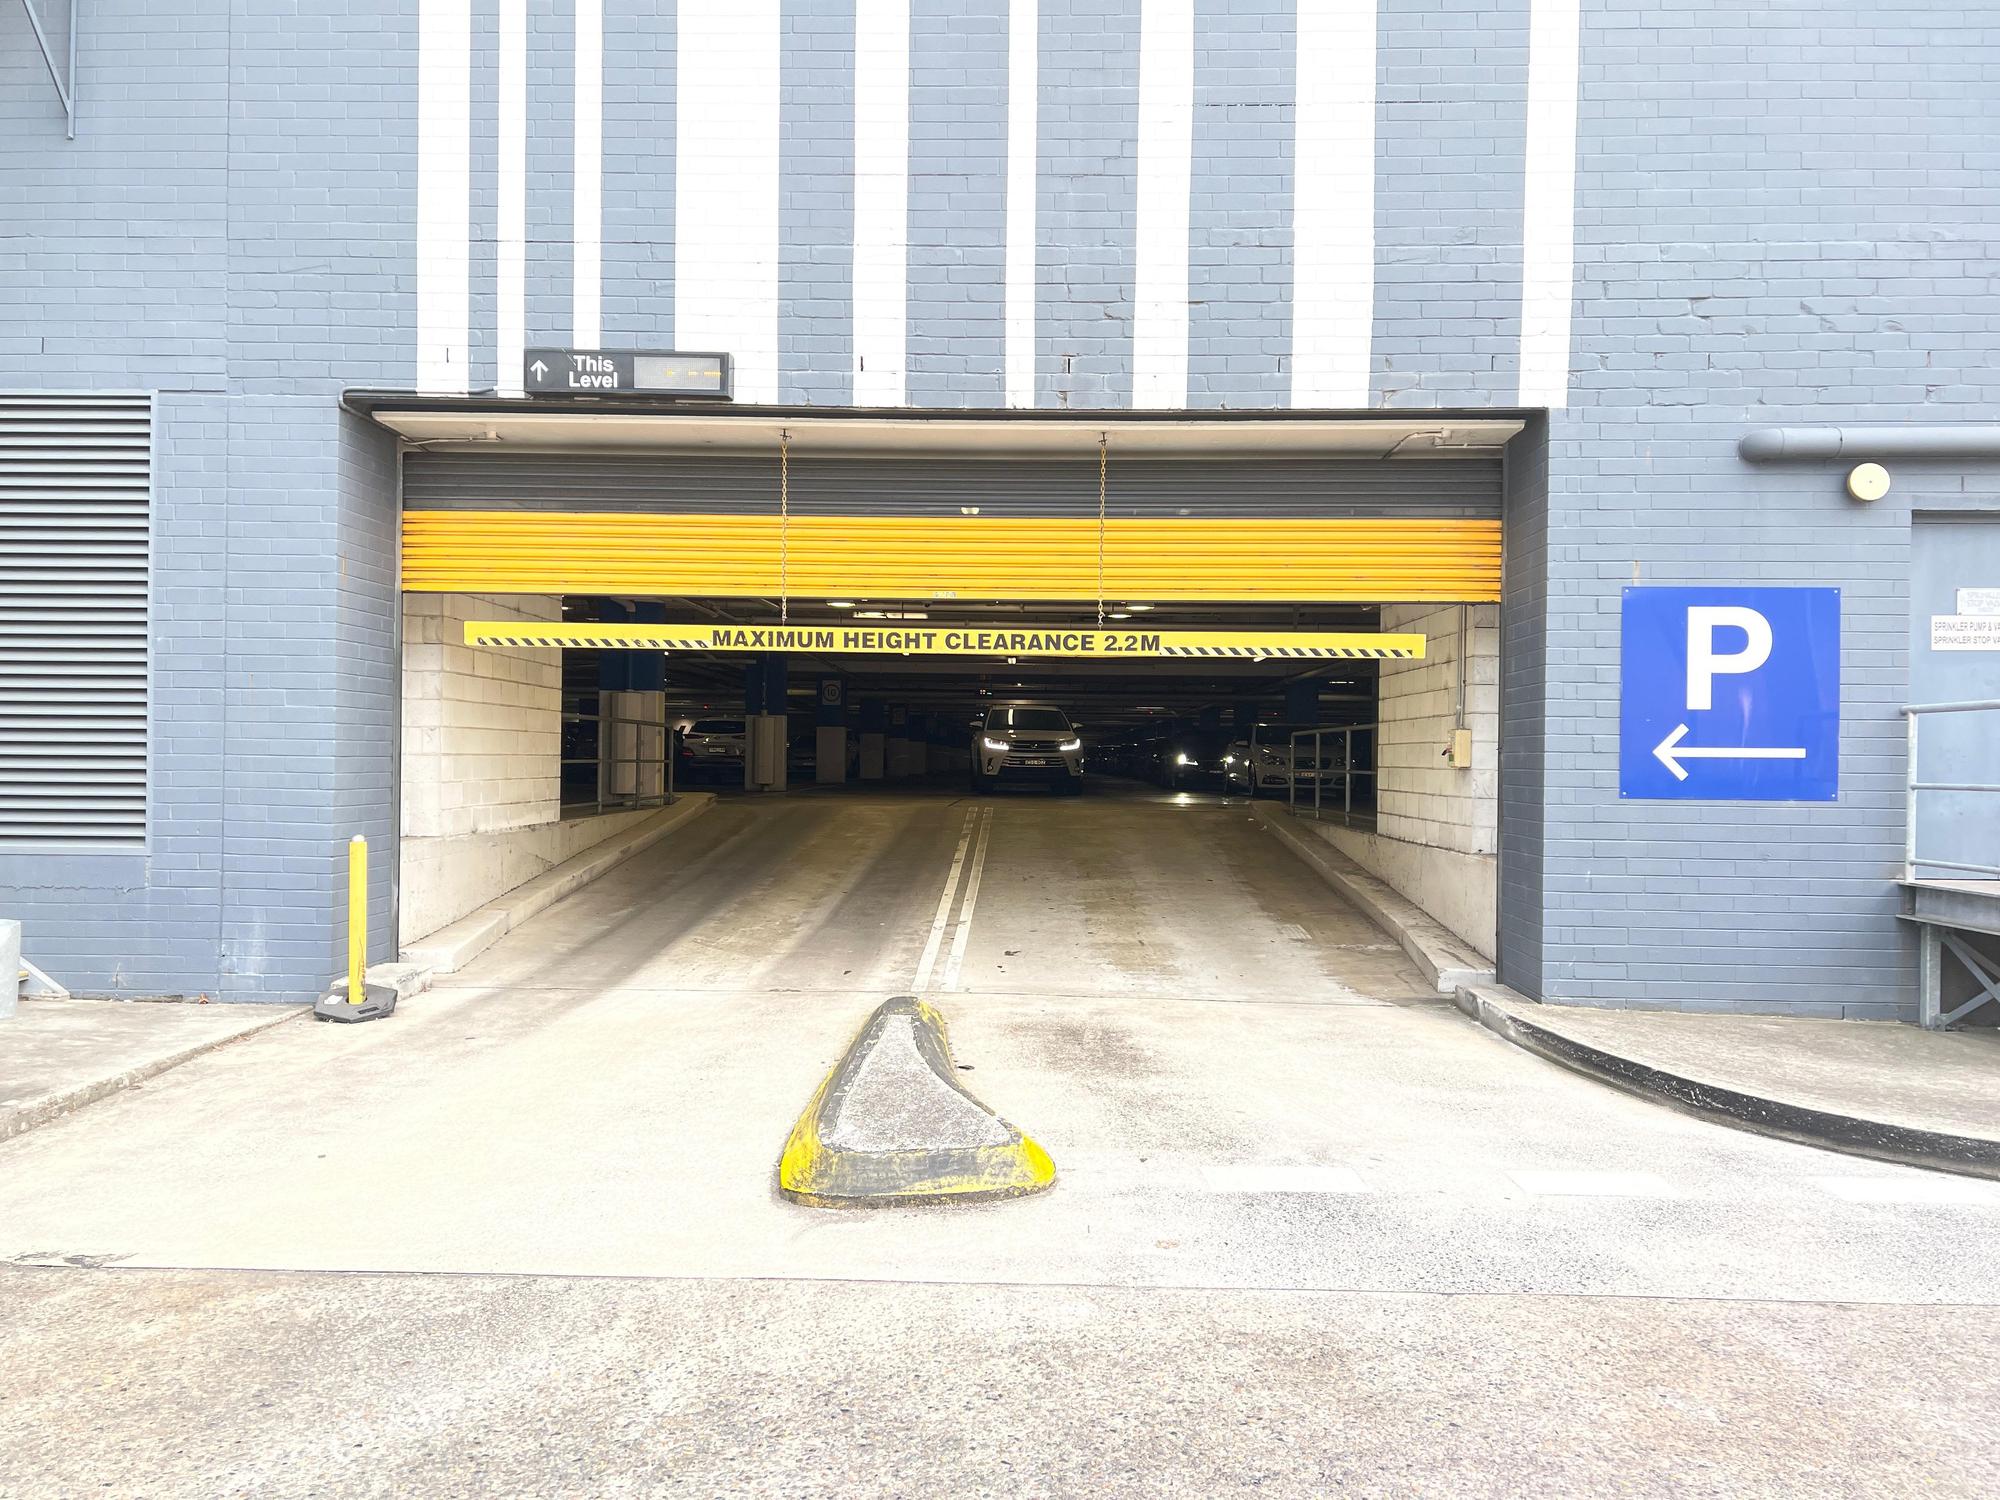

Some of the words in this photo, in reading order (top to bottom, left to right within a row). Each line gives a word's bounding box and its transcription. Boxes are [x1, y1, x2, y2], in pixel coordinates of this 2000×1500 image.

[573, 355, 614, 372] This
[569, 371, 618, 388] Level
[1934, 622, 1968, 631] SPRINKLER
[712, 630, 833, 649] MAXIMUM
[844, 632, 937, 650] HEIGHT
[945, 632, 1095, 651] CLEARANCE
[1104, 634, 1160, 652] 2.2M
[1933, 636, 1971, 644] SPRINKLER
[1973, 636, 1991, 644] STOP
[1686, 606, 1773, 710] P
[827, 687, 837, 697] 10
